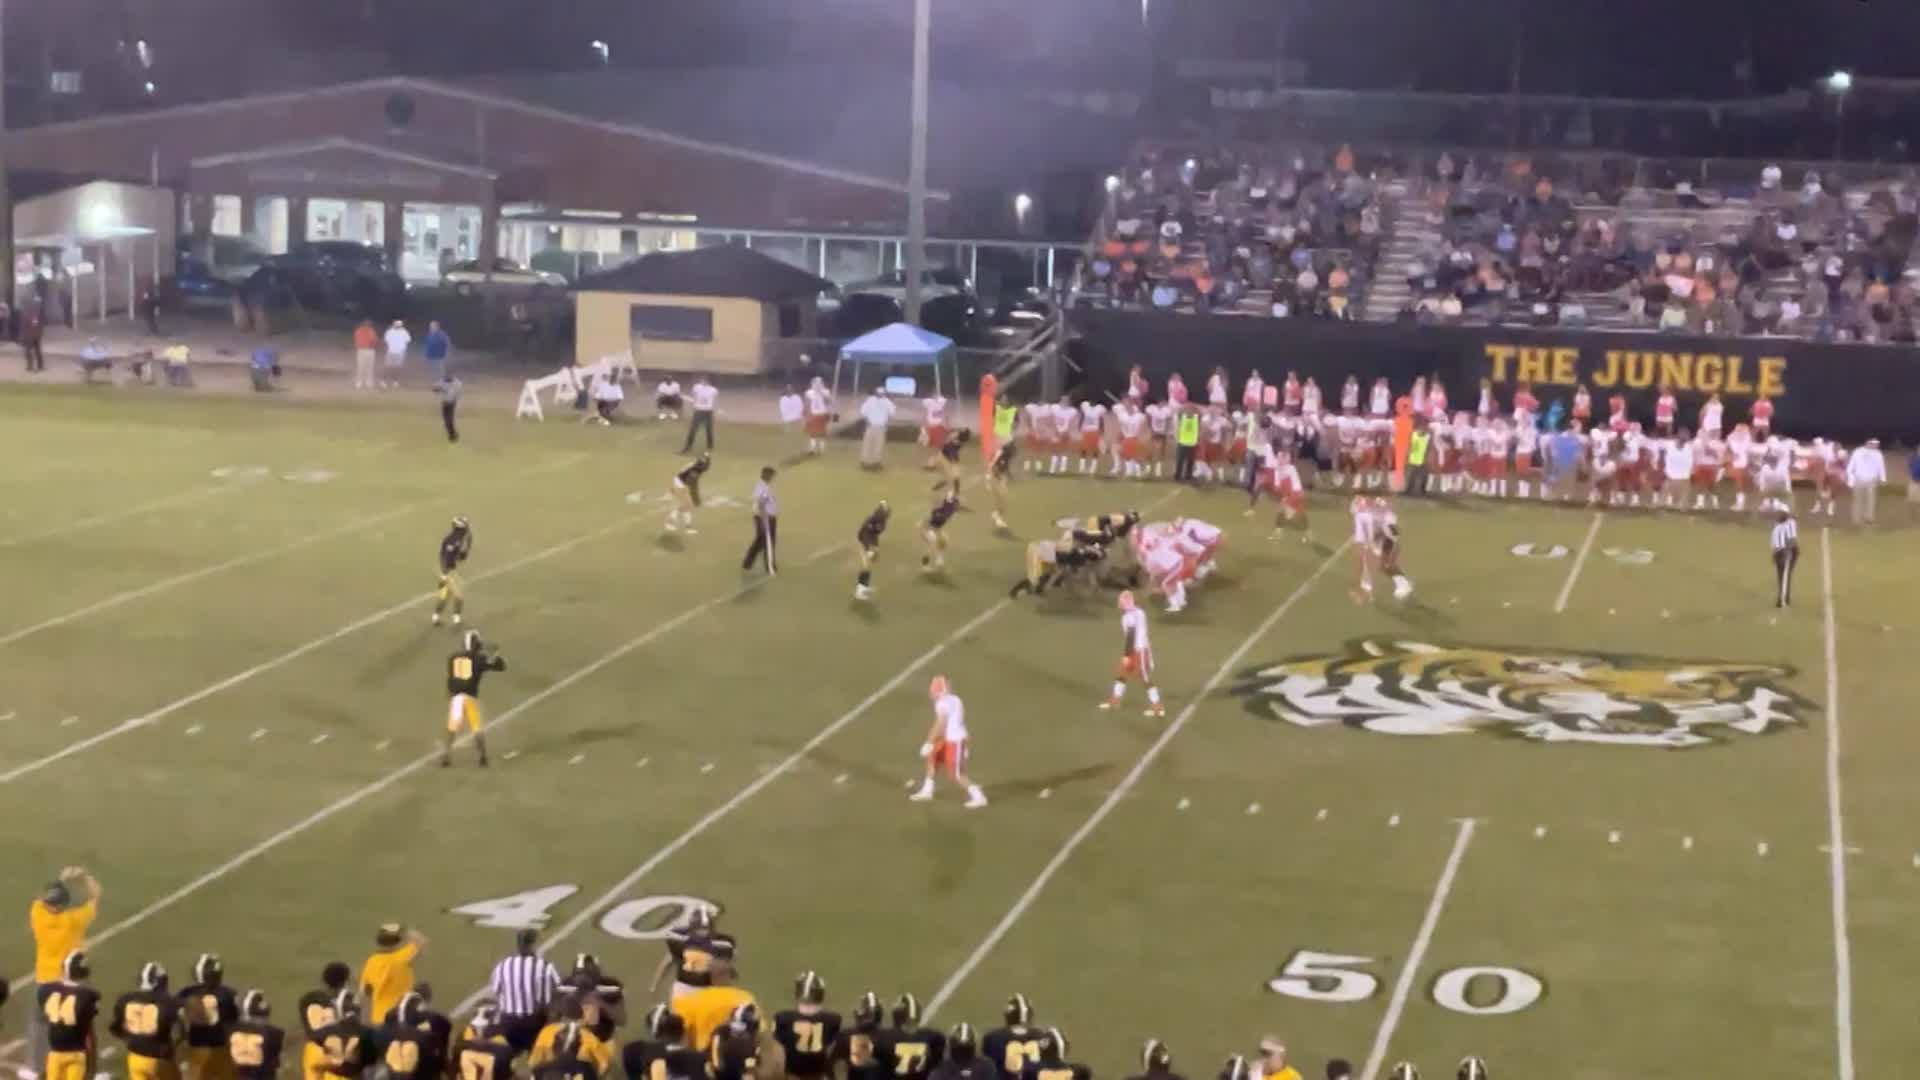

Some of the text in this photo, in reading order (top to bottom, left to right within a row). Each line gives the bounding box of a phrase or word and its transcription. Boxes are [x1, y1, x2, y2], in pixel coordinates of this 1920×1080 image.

[1485, 345, 1787, 395] THE JUNGLE
[44, 991, 77, 1026] 44
[793, 1020, 824, 1052] 71
